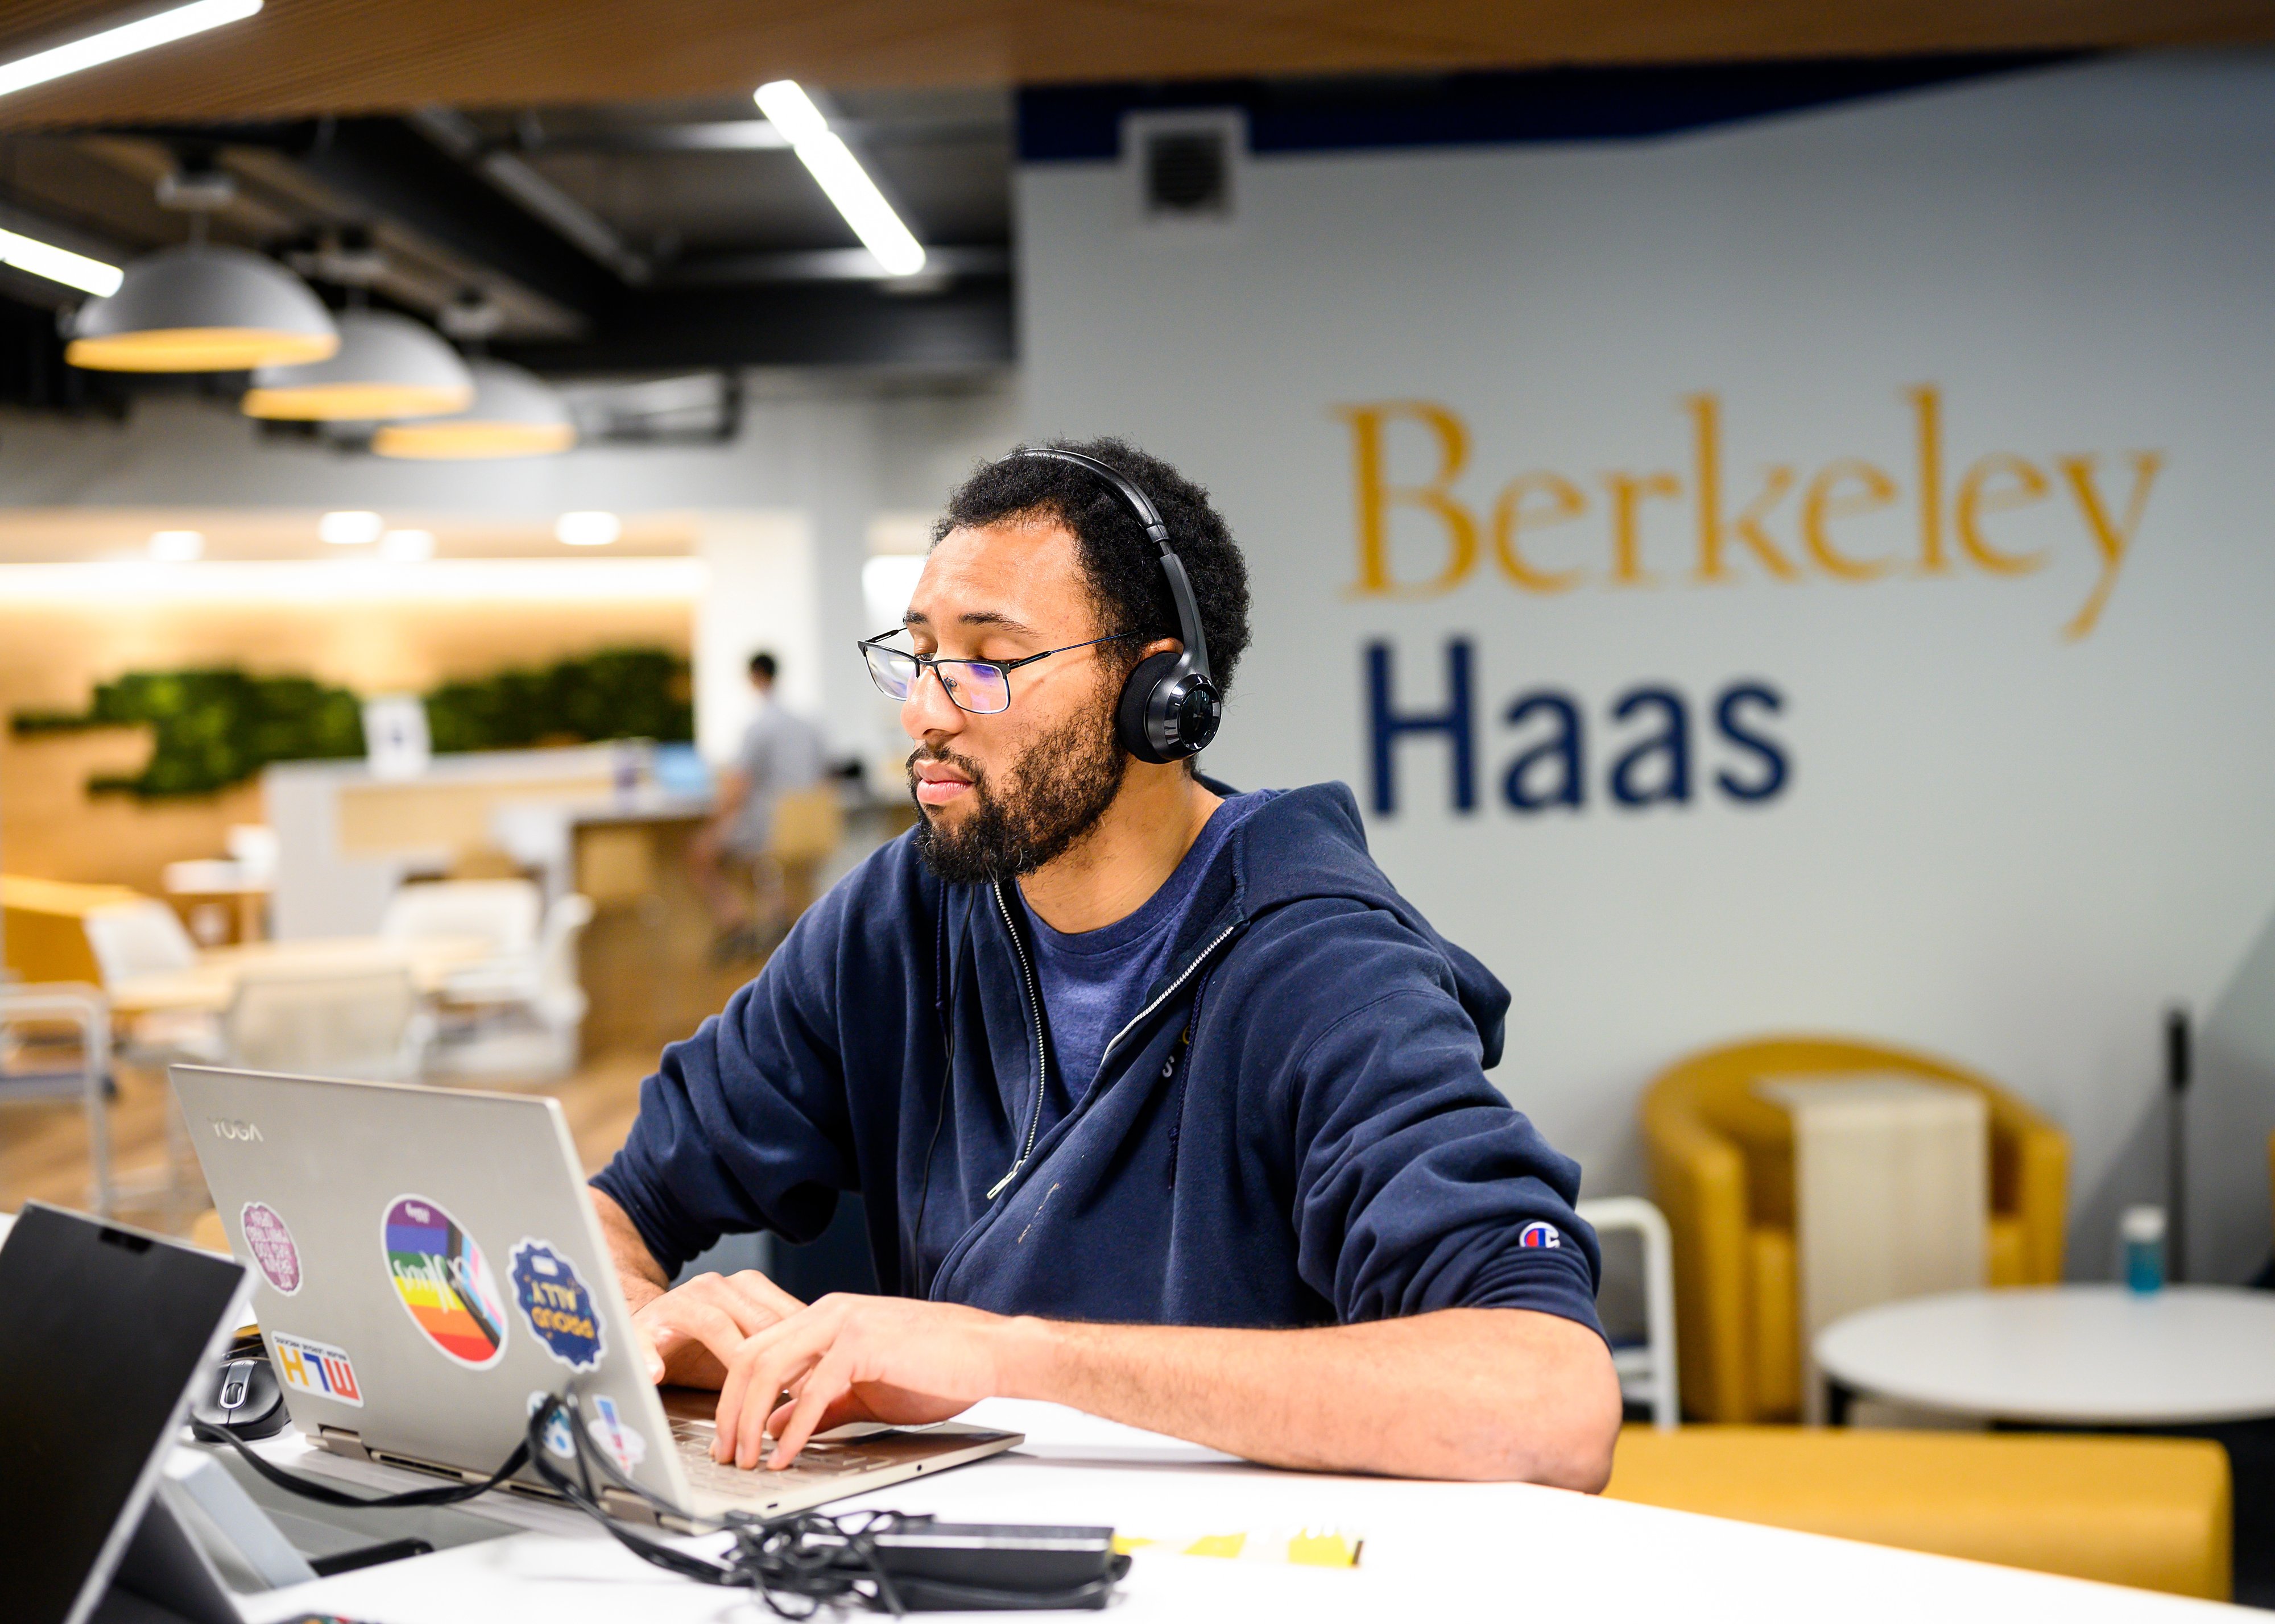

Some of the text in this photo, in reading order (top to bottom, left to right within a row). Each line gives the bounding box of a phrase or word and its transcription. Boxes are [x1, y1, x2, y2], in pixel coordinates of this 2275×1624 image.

[1330, 382, 2164, 643] Berkeley
[1363, 635, 1794, 818] Haas
[531, 1281, 577, 1312] ALLY
[531, 1306, 595, 1339] PROUD
[278, 1345, 360, 1401] MLH
